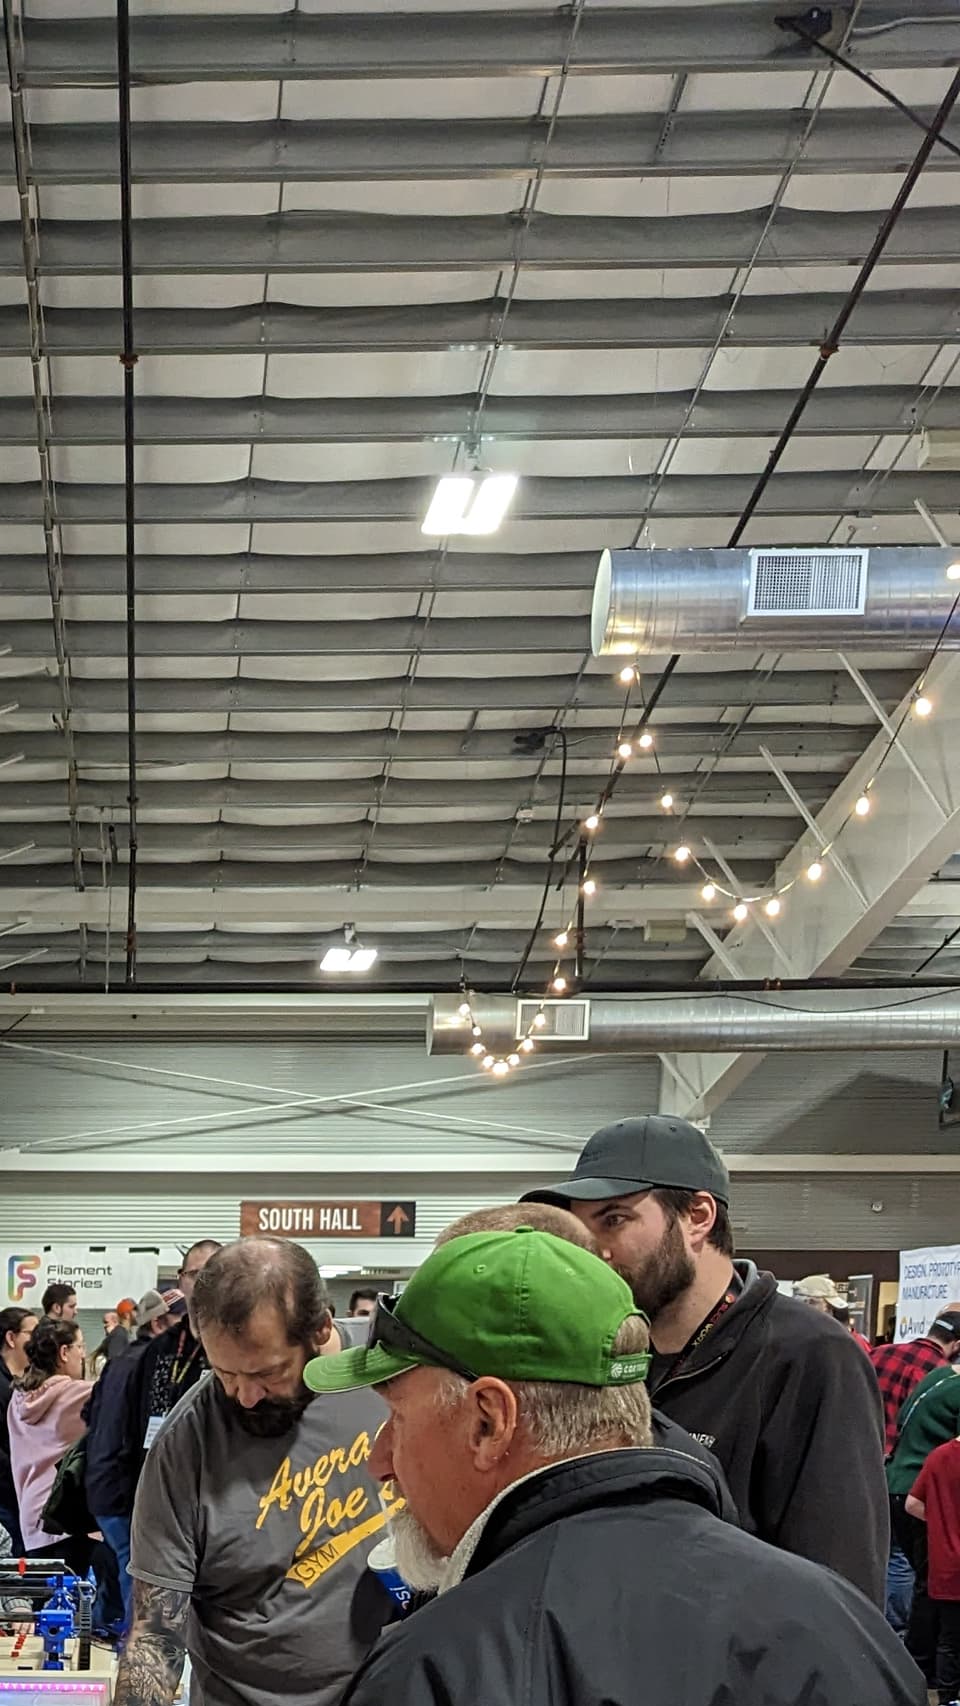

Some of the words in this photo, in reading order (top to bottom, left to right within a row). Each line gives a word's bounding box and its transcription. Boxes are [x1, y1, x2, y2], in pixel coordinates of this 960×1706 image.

[258, 1207, 313, 1231] SOUTH
[319, 1207, 362, 1231] HALL
[47, 1264, 112, 1276] Filament
[47, 1278, 103, 1289] Stories
[293, 1542, 340, 1581] GYM
